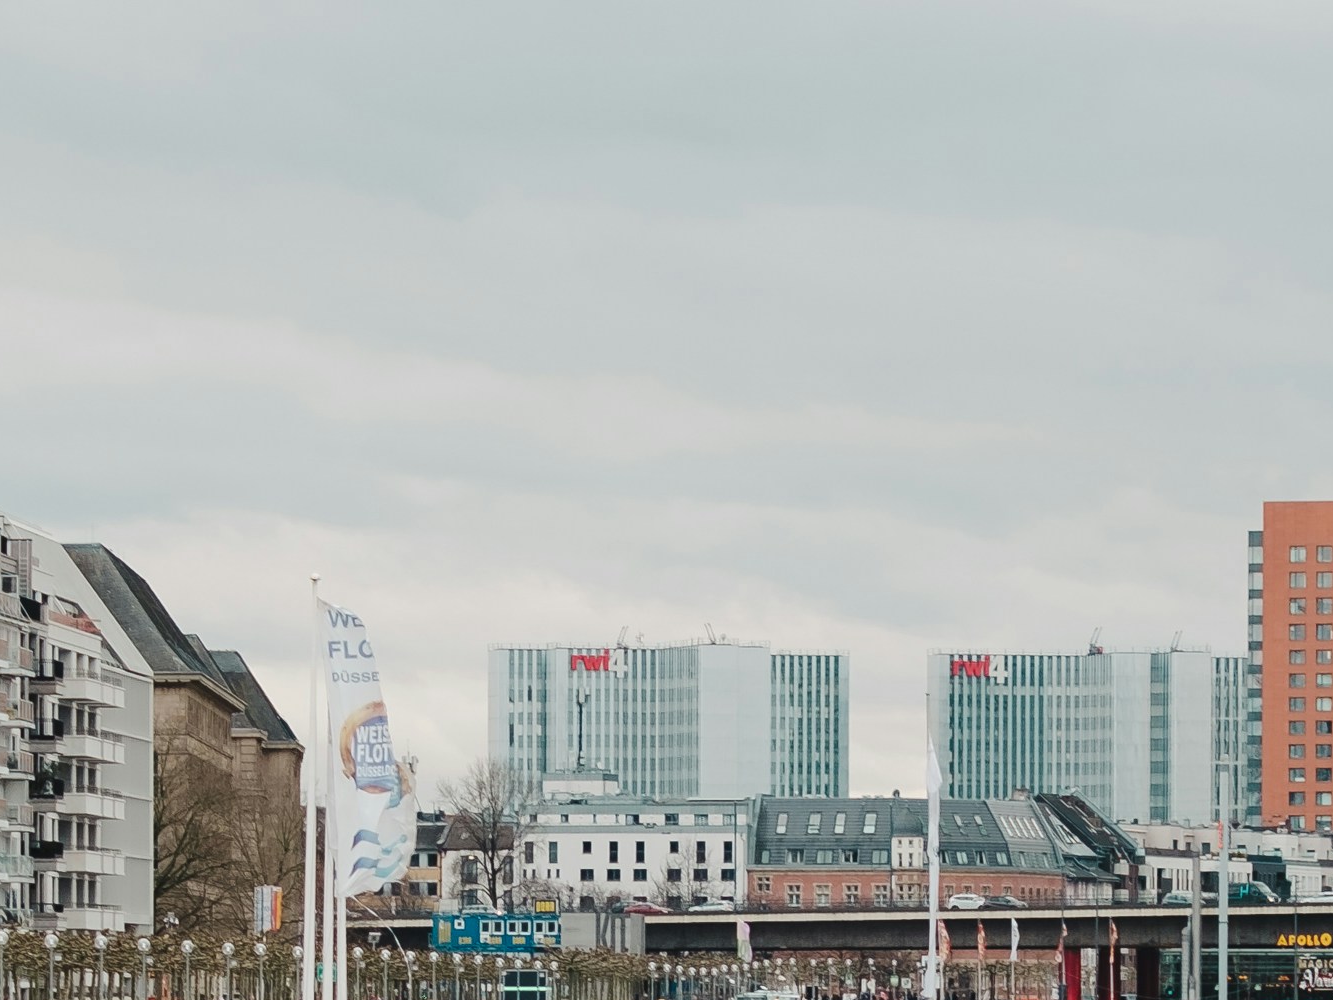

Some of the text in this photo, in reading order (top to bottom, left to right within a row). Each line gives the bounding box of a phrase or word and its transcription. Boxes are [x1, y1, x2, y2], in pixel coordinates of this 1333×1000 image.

[570, 648, 628, 679] rwi4
[952, 654, 1008, 684] rwi4
[1276, 932, 1332, 946] APOLLO
